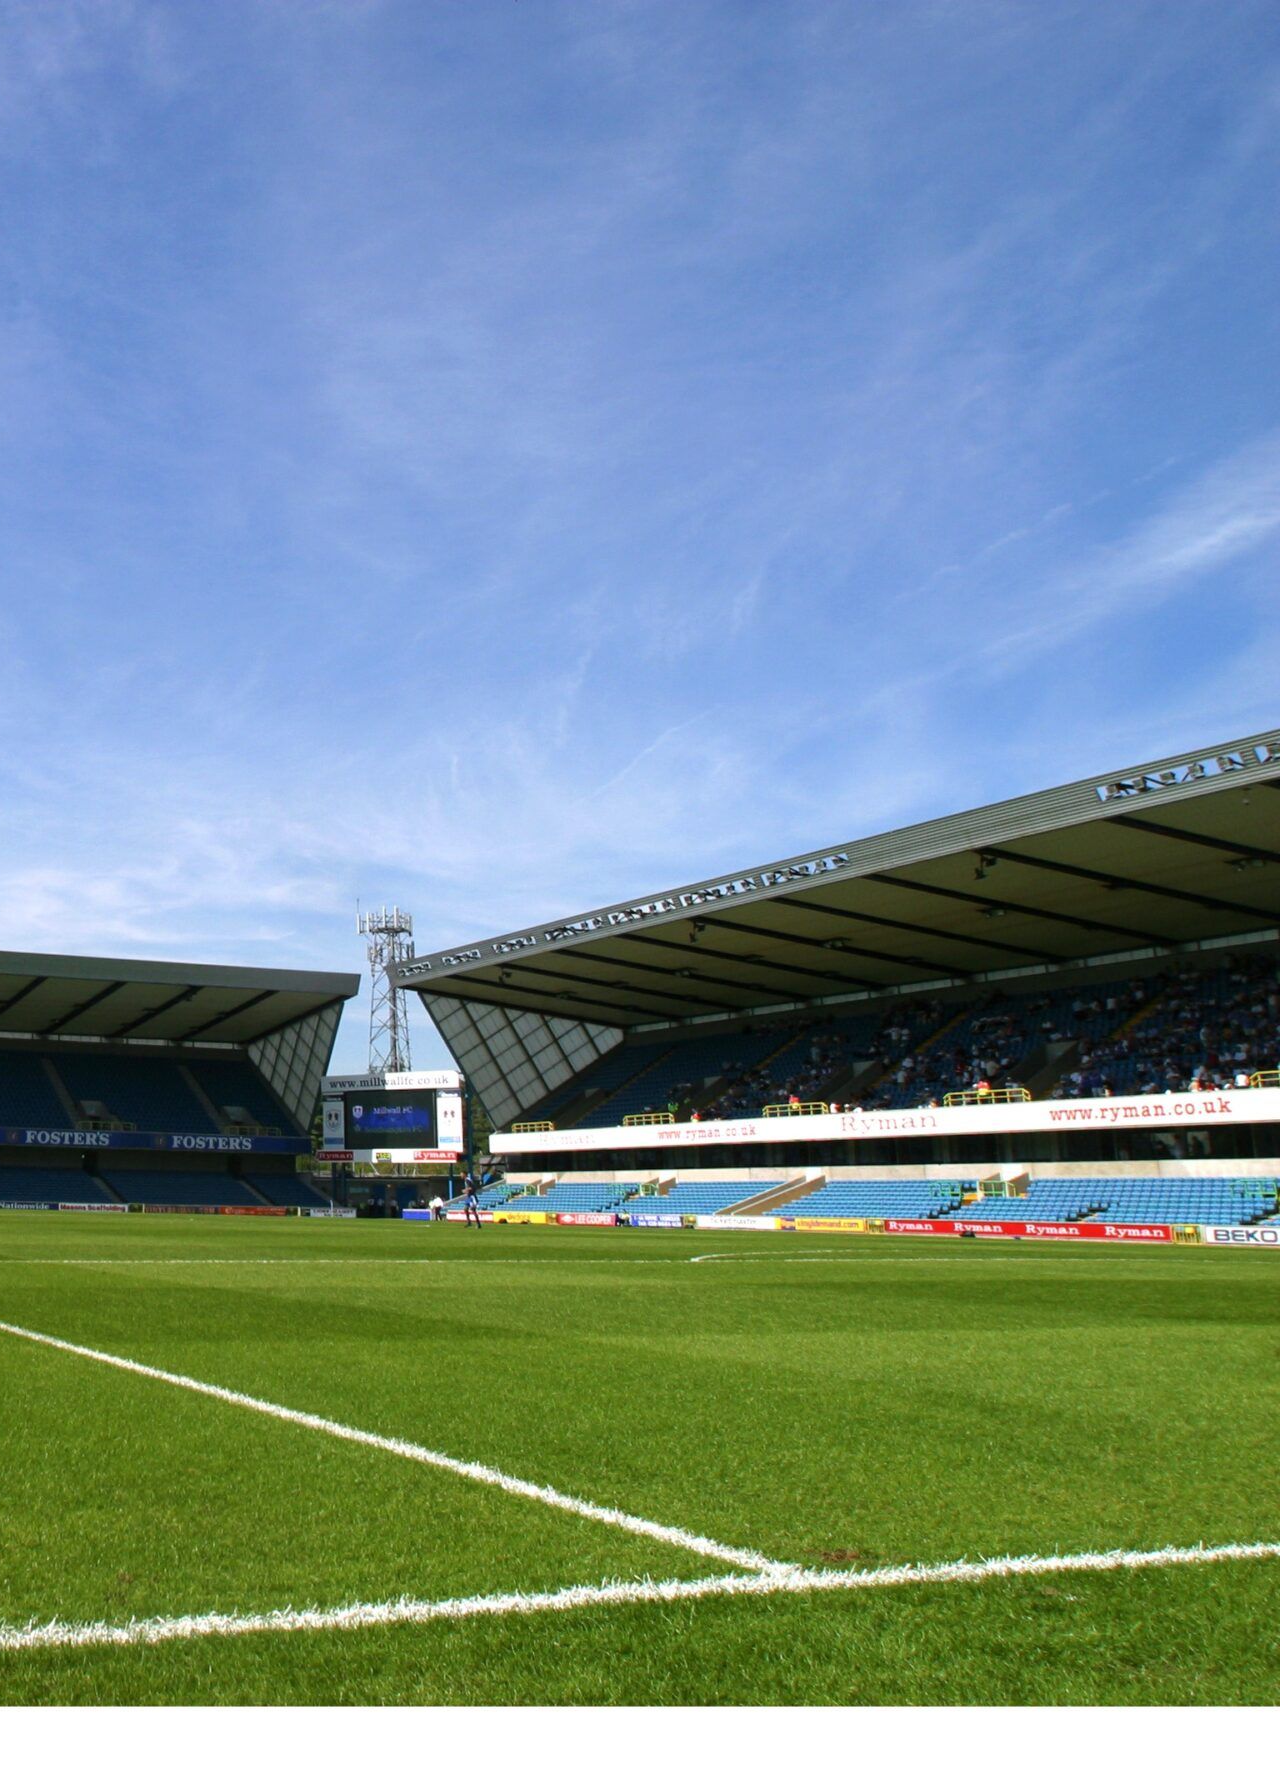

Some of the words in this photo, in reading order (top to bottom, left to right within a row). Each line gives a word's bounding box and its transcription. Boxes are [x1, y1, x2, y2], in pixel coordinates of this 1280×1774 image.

[1049, 1098, 1233, 1122] www.ryman.co.uk
[841, 1115, 937, 1134] Ryman
[25, 1130, 110, 1146] FOSTER'S
[172, 1135, 252, 1150] FOSTER'S
[414, 1151, 457, 1160] Ryman
[586, 1215, 612, 1224] COOPER
[889, 1221, 934, 1233] Ryman
[953, 1222, 1003, 1234] Ryman
[1025, 1224, 1080, 1237] Ryman
[1105, 1226, 1165, 1239] Ryman
[1214, 1229, 1278, 1243] BEKO
